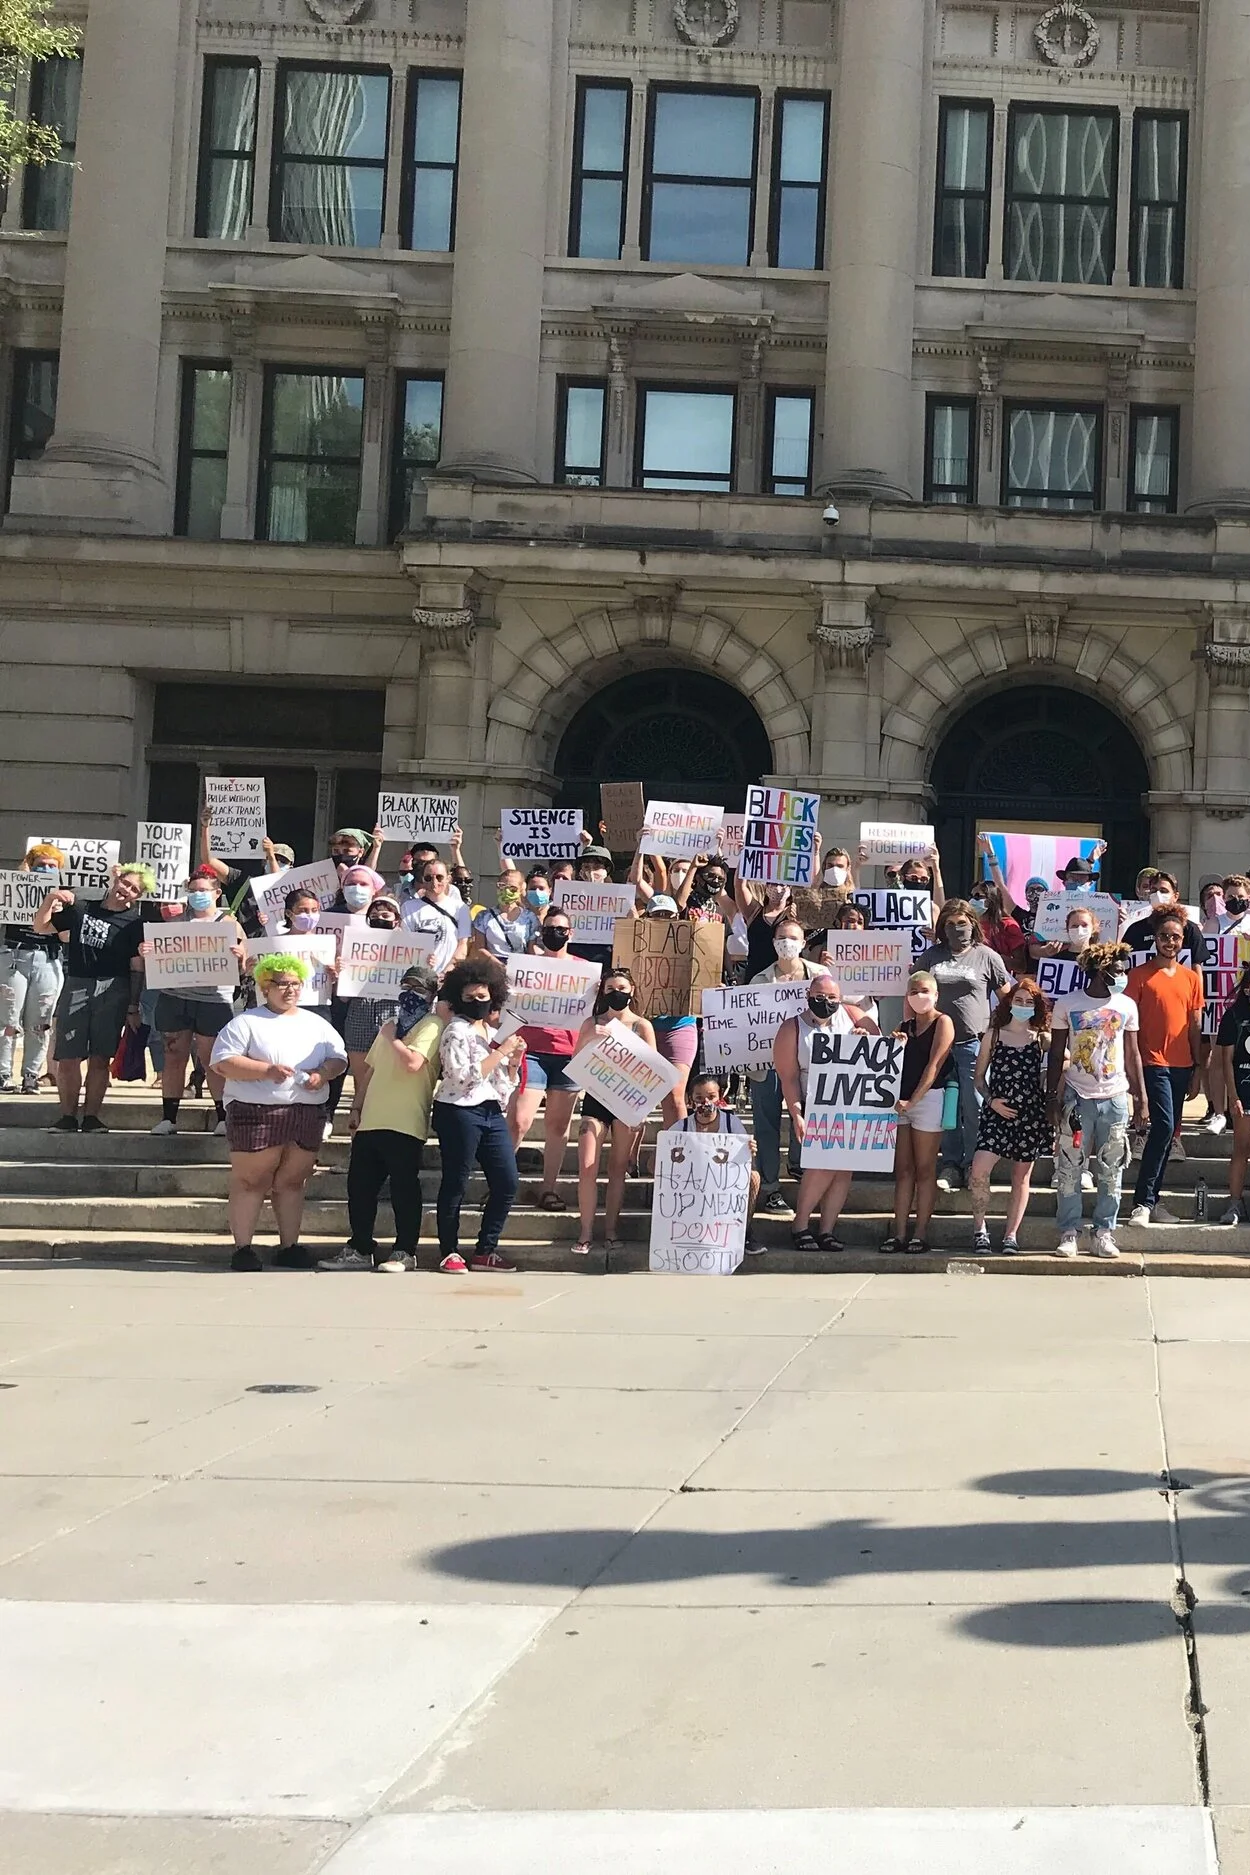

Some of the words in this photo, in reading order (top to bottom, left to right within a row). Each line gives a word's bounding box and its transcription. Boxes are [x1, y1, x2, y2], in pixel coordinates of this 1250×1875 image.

[209, 783, 233, 792] THERE
[235, 784, 245, 792] IS
[247, 784, 260, 792] NO
[208, 794, 228, 803] PRIDE
[382, 795, 420, 812] BLACK
[420, 797, 457, 816] TRANS
[750, 789, 818, 823] BLACK
[209, 805, 233, 815] BLACK
[235, 806, 261, 815] TRANS
[509, 809, 576, 826] SILENCE
[380, 814, 411, 829] LIVES
[414, 815, 457, 832] MATTER
[652, 812, 713, 831] RESILIENT
[145, 824, 183, 841] YOUR
[528, 827, 551, 839] IS
[651, 828, 711, 850] TOGETHER
[751, 821, 813, 851] LIVES
[141, 842, 183, 860] FIGHT
[502, 842, 581, 858] COMPLICITY
[869, 839, 926, 855] TOGETHER
[69, 855, 108, 873] VES
[157, 862, 179, 880] MY
[743, 850, 811, 883] MATTER
[59, 872, 110, 888] TTER
[146, 883, 183, 900] GHT
[562, 893, 626, 913] RESILIENT
[567, 915, 615, 931] OGETHE
[153, 936, 227, 954] RESILIENT
[633, 919, 705, 955] BLACK
[351, 942, 424, 965] RESILIENT
[835, 944, 902, 962] RESILIENT
[156, 957, 229, 974] TOGETHER
[349, 964, 403, 986] TOGETH
[836, 965, 901, 982] TOGETHER
[515, 969, 590, 995] RESILIENT
[1039, 963, 1089, 994] BLA
[1206, 972, 1243, 997] LIV
[514, 992, 587, 1017] TOGETHER
[715, 988, 761, 1010] THERE
[704, 1015, 737, 1030] TIME
[747, 1010, 787, 1026] WHEN
[719, 1043, 732, 1056] IS
[811, 1033, 904, 1075] BLACK
[597, 1034, 666, 1092] RESILIENT
[706, 1062, 751, 1075] #BLACK
[756, 1061, 774, 1071] LIV
[583, 1053, 648, 1111] TOGETHER
[814, 1073, 896, 1108] LIVES
[803, 1112, 899, 1150] MATTER
[656, 1161, 751, 1193] HANDS
[659, 1192, 695, 1218] UP
